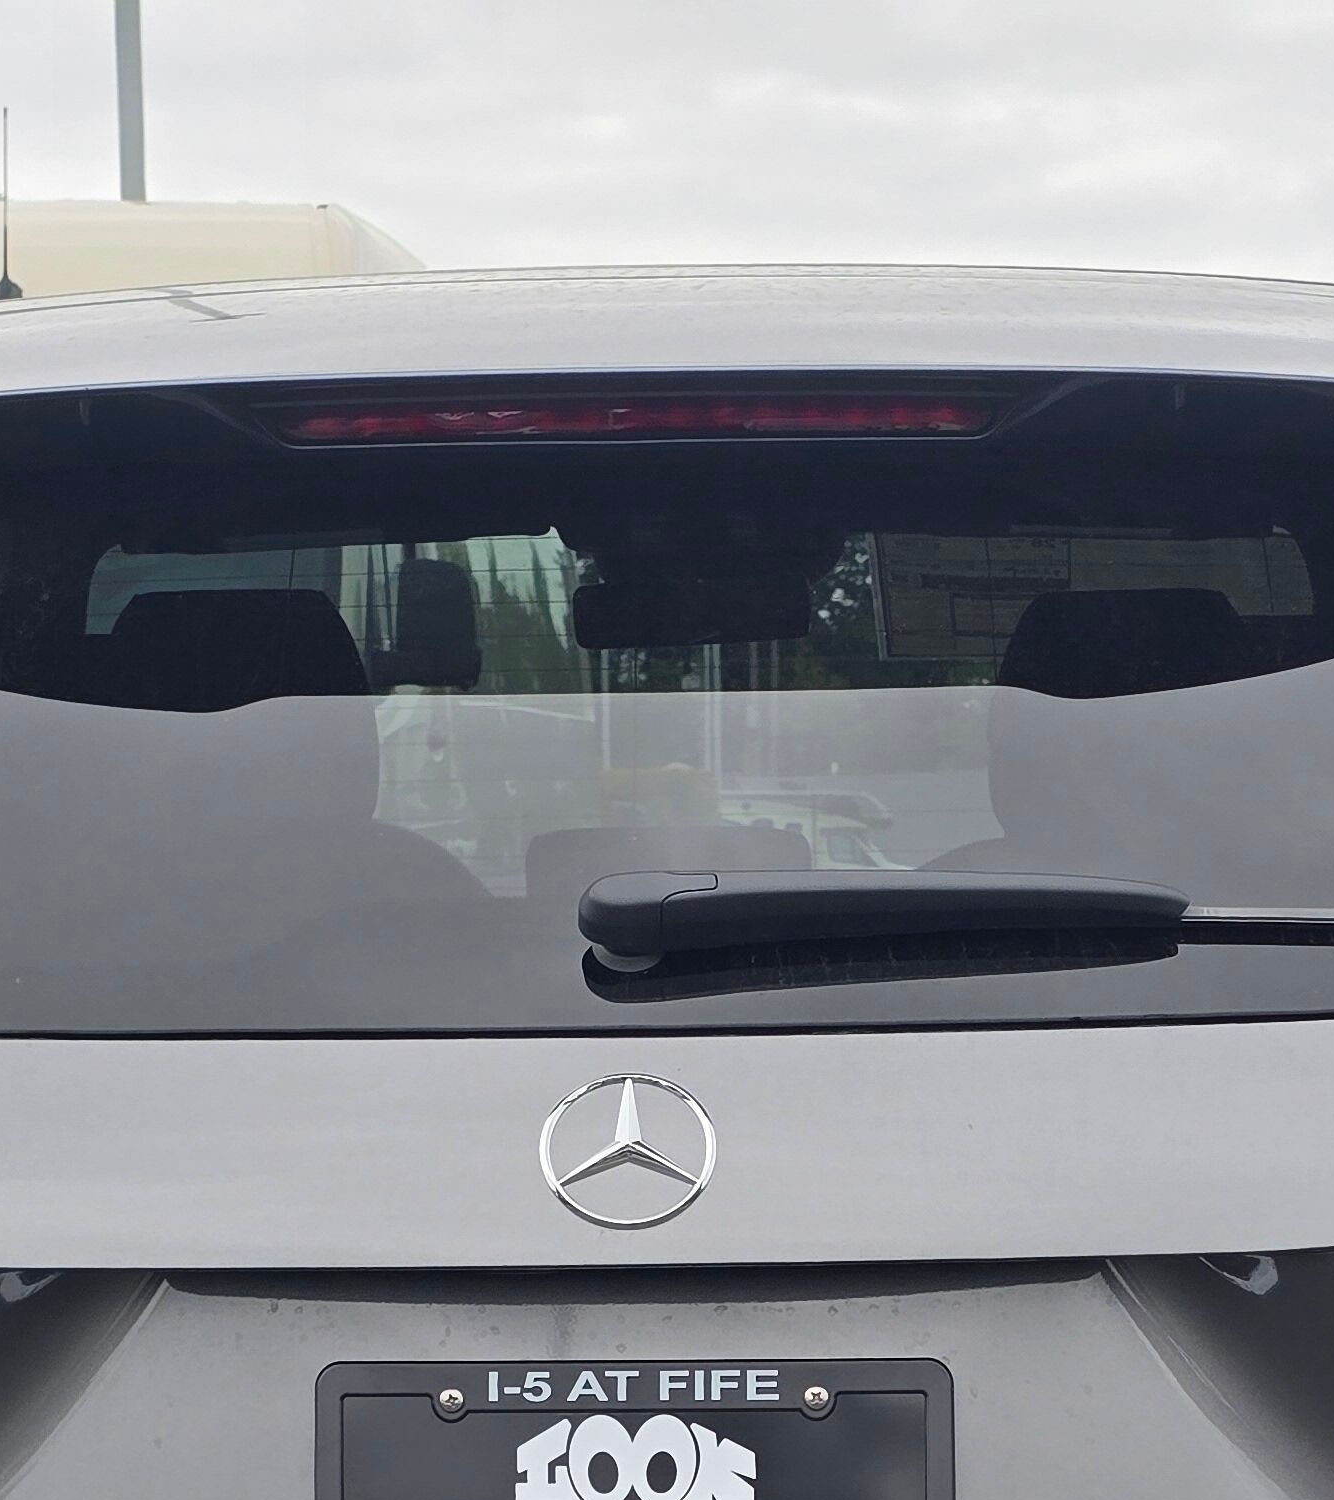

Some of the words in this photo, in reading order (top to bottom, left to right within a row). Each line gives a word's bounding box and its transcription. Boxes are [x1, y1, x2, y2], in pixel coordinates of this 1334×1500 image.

[488, 1371, 551, 1403] I-5
[567, 1370, 639, 1402] AT
[659, 1369, 780, 1402] FIFE
